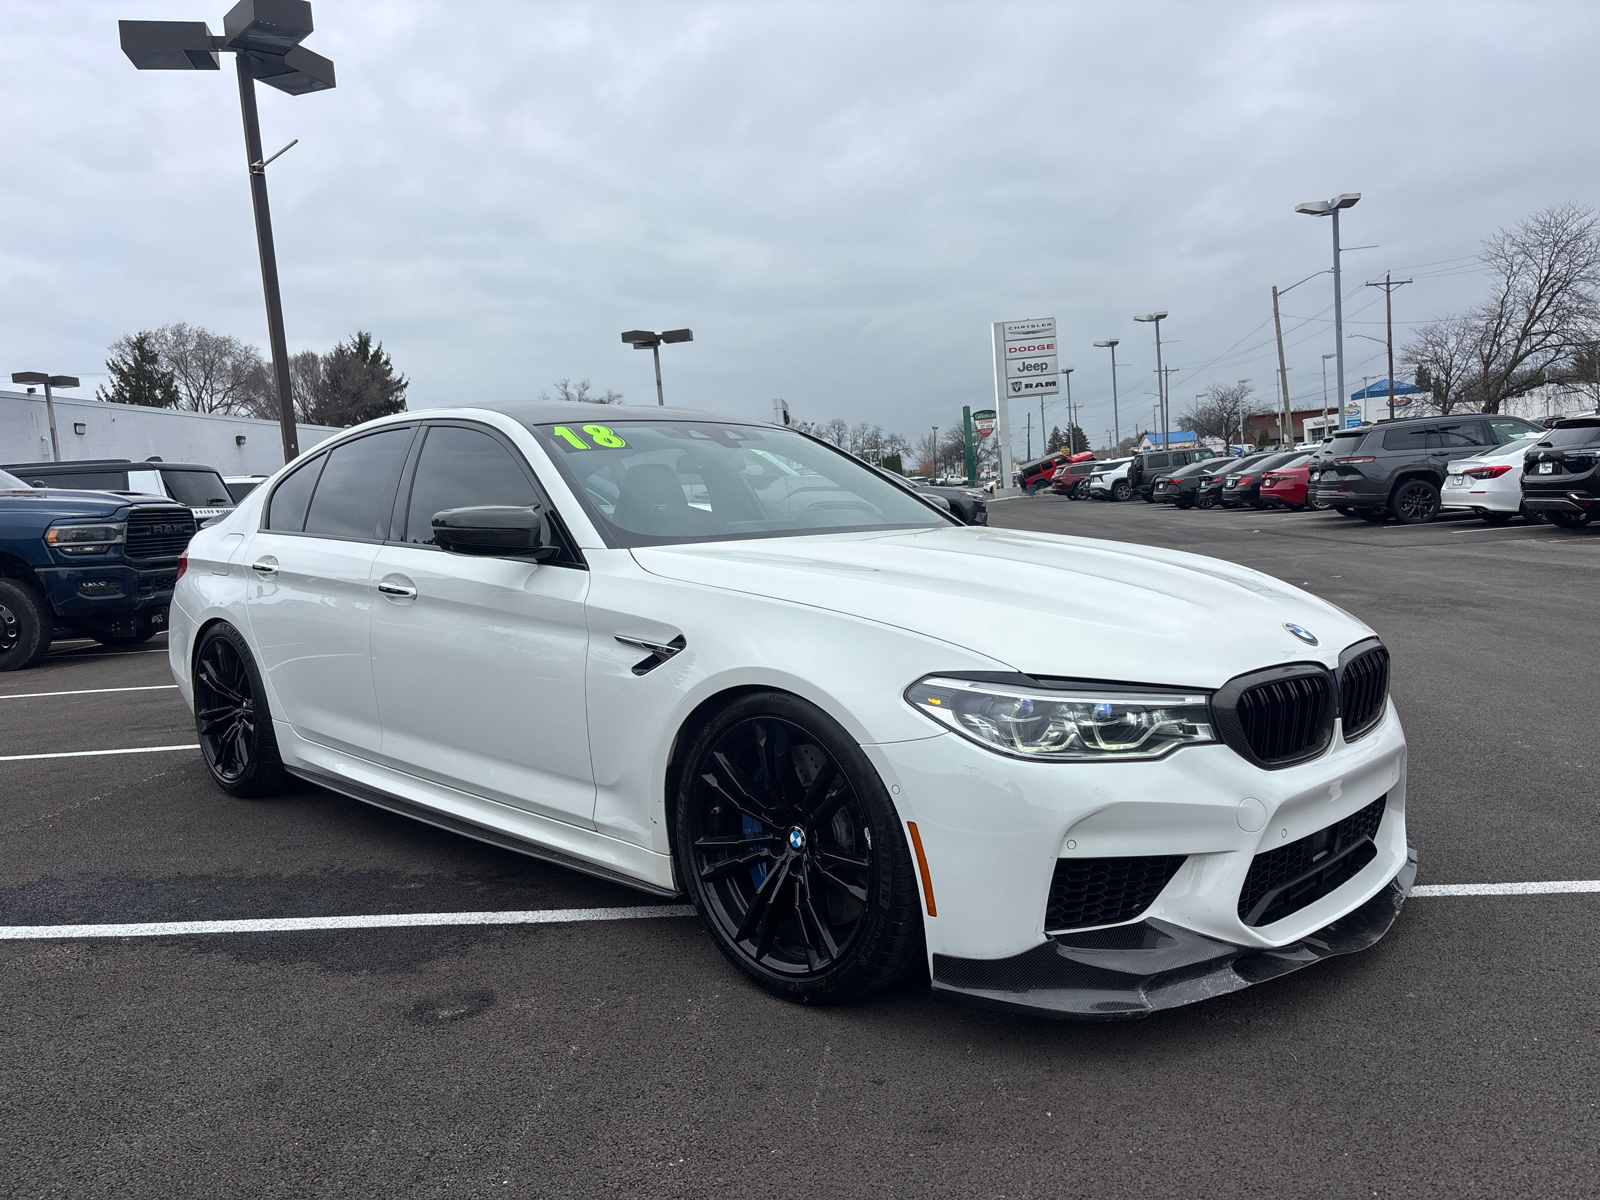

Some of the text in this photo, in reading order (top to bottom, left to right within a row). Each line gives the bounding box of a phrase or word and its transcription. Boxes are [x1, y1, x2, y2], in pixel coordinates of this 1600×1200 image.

[1008, 322, 1052, 330] CHRYSLER
[1008, 343, 1054, 353] DODGE
[1017, 361, 1048, 373] Jeep
[1024, 380, 1057, 389] RAM
[554, 424, 626, 450] 18
[153, 524, 184, 534] RAM
